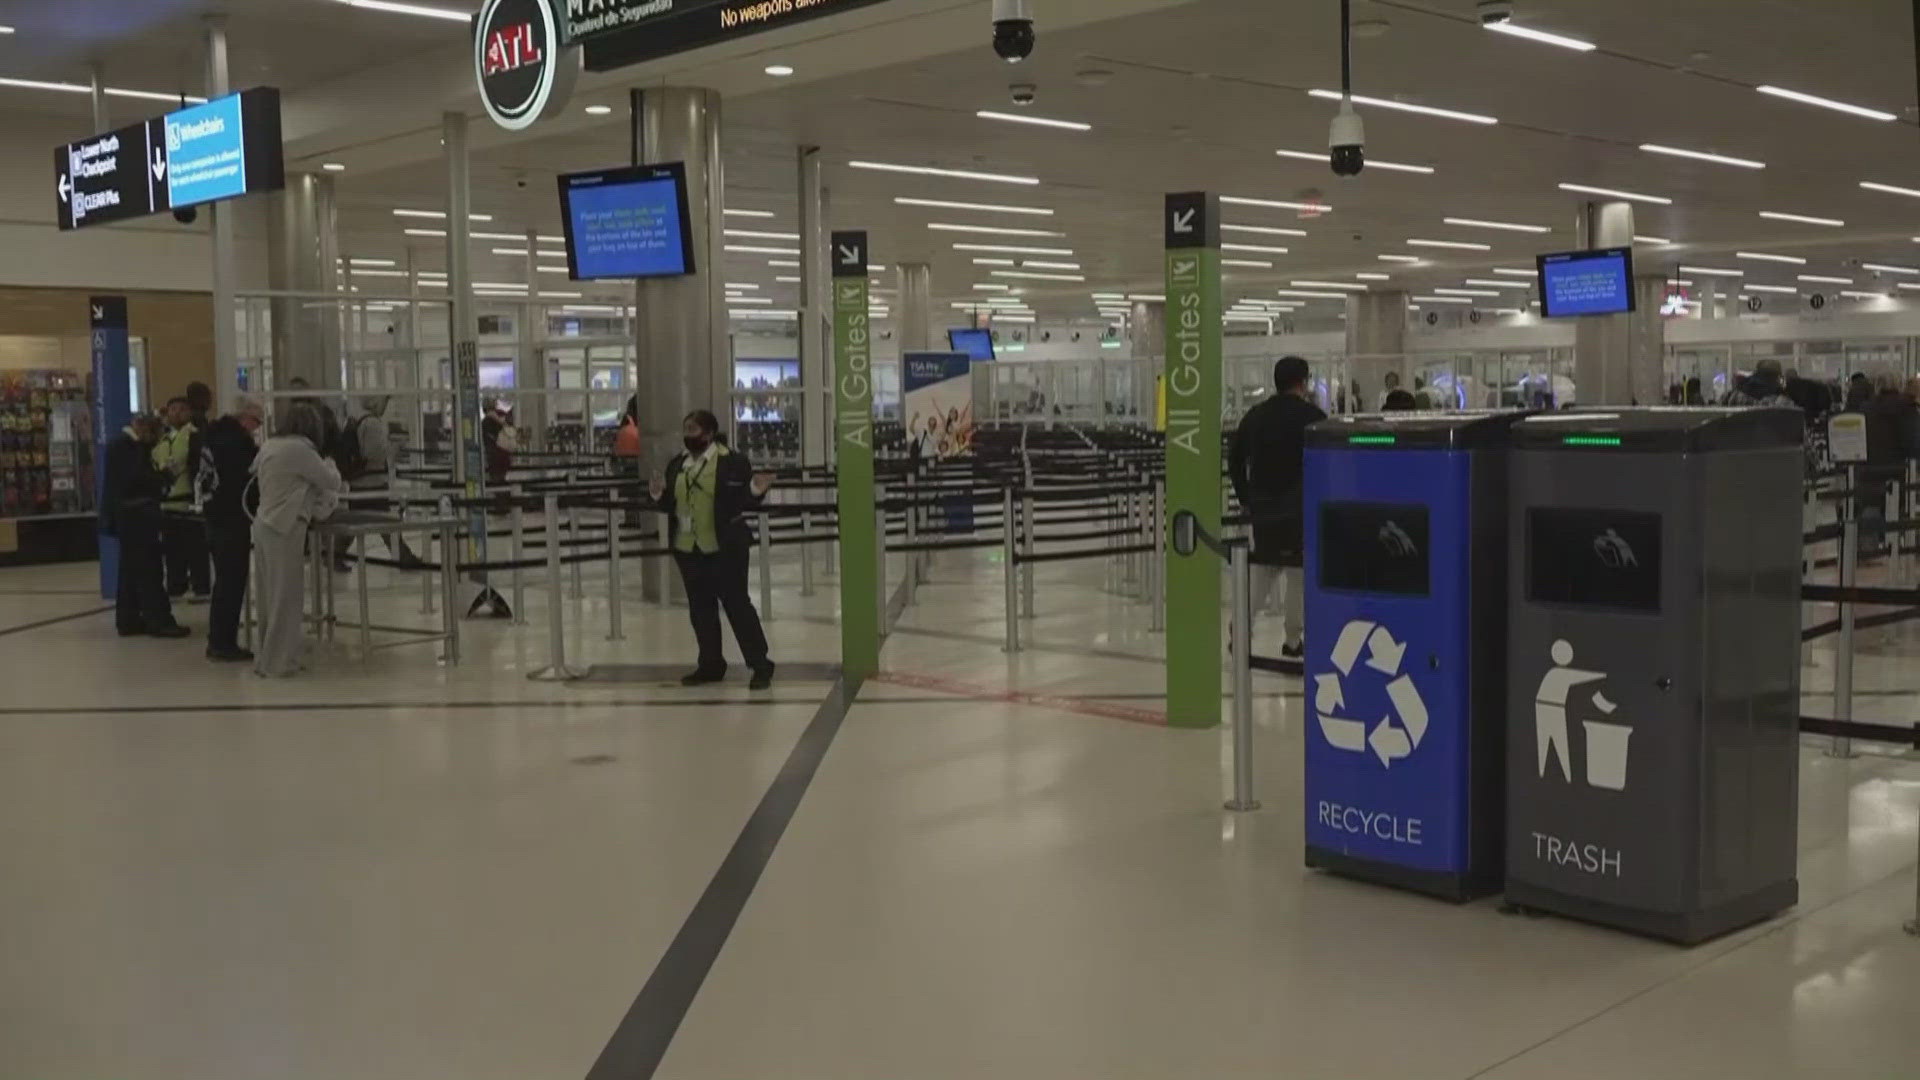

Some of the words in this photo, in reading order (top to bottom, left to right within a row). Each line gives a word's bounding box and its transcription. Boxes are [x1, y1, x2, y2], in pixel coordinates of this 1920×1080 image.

[568, 13, 603, 36] Control
[604, 11, 619, 26] de
[720, 8, 737, 28] No
[739, 0, 793, 23] weapons
[484, 23, 541, 77] ATL
[841, 313, 868, 401] Gates
[1170, 292, 1200, 396] Gates
[840, 410, 869, 448] All
[1169, 408, 1200, 455] All
[1319, 801, 1422, 846] RECYCLE
[1532, 831, 1621, 877] TRASH
